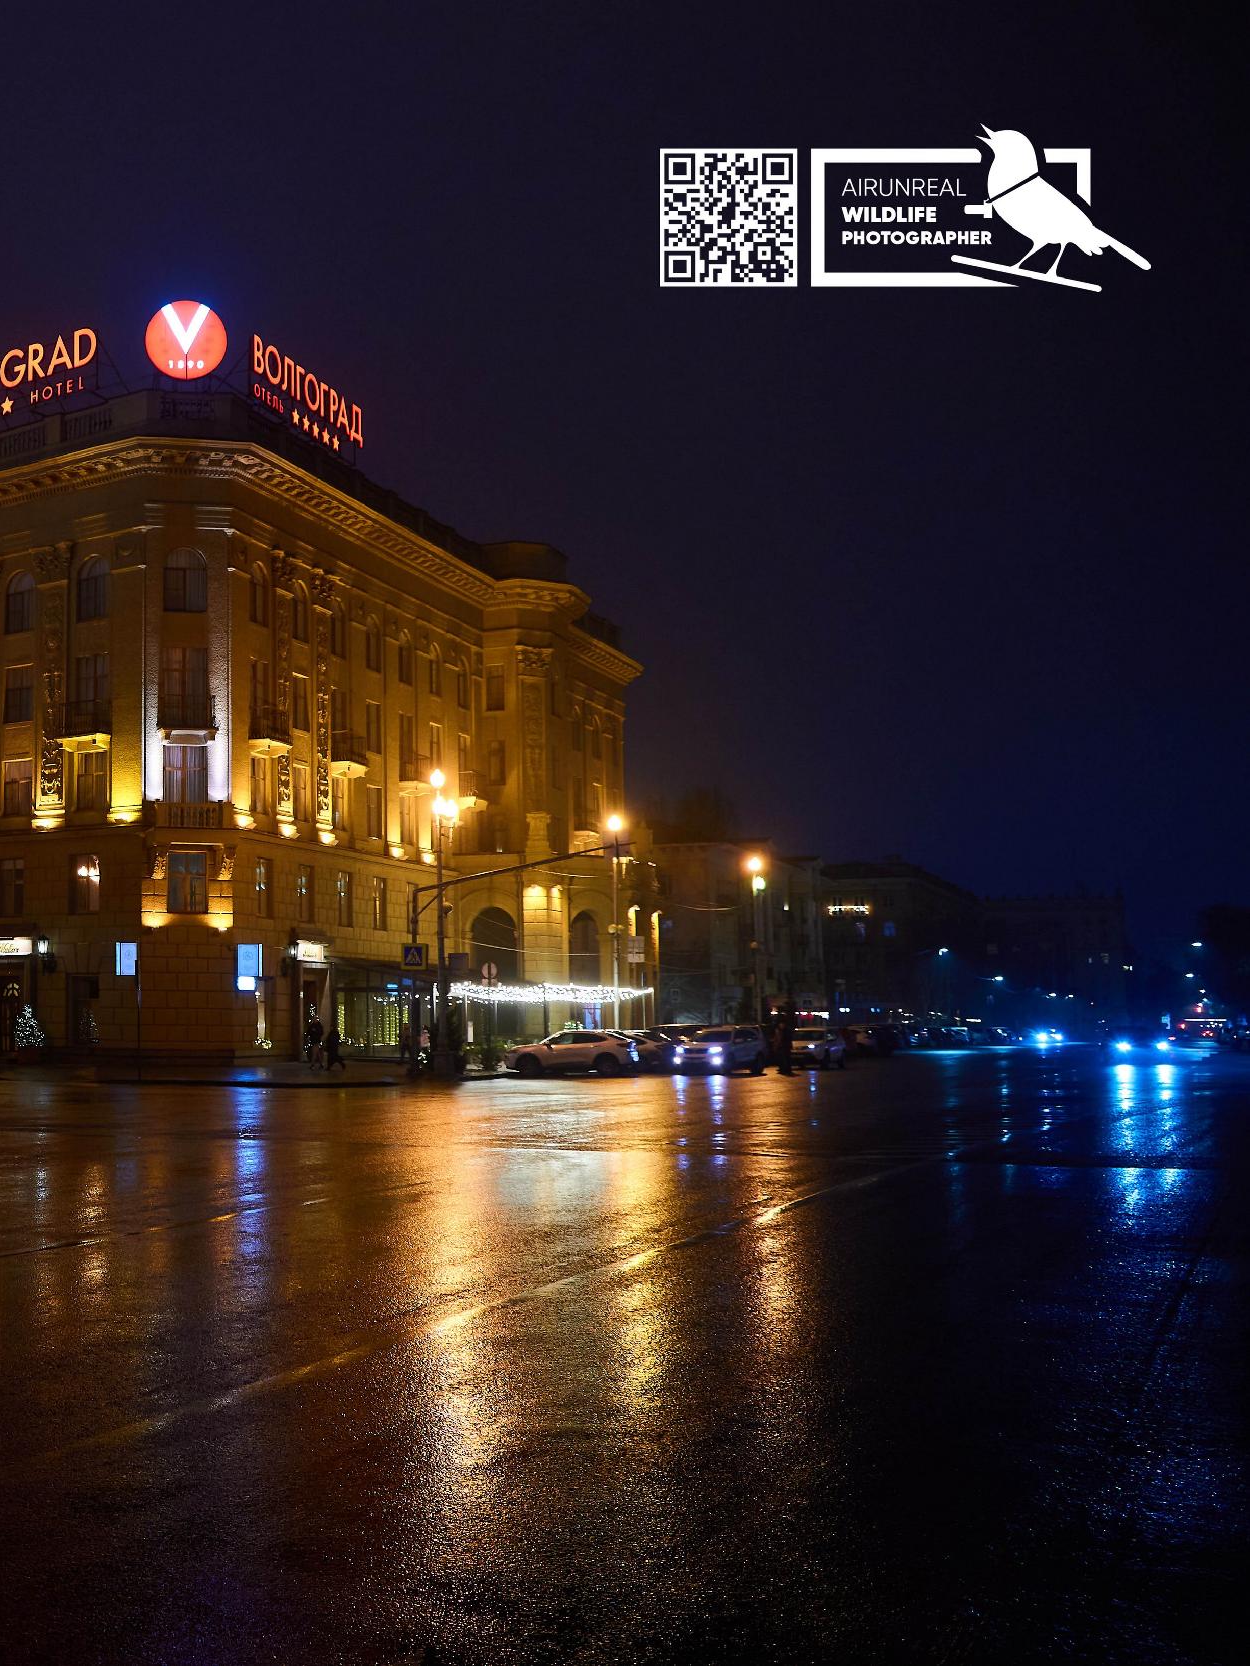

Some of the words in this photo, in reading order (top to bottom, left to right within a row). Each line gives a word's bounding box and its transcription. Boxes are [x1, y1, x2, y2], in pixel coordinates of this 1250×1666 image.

[161, 303, 212, 355] V
[168, 359, 205, 369] 1890
[30, 376, 84, 404] HOTEL
[254, 333, 363, 449] ВОЛГОГРАД
[254, 383, 284, 413] ОТЕЛЬ
